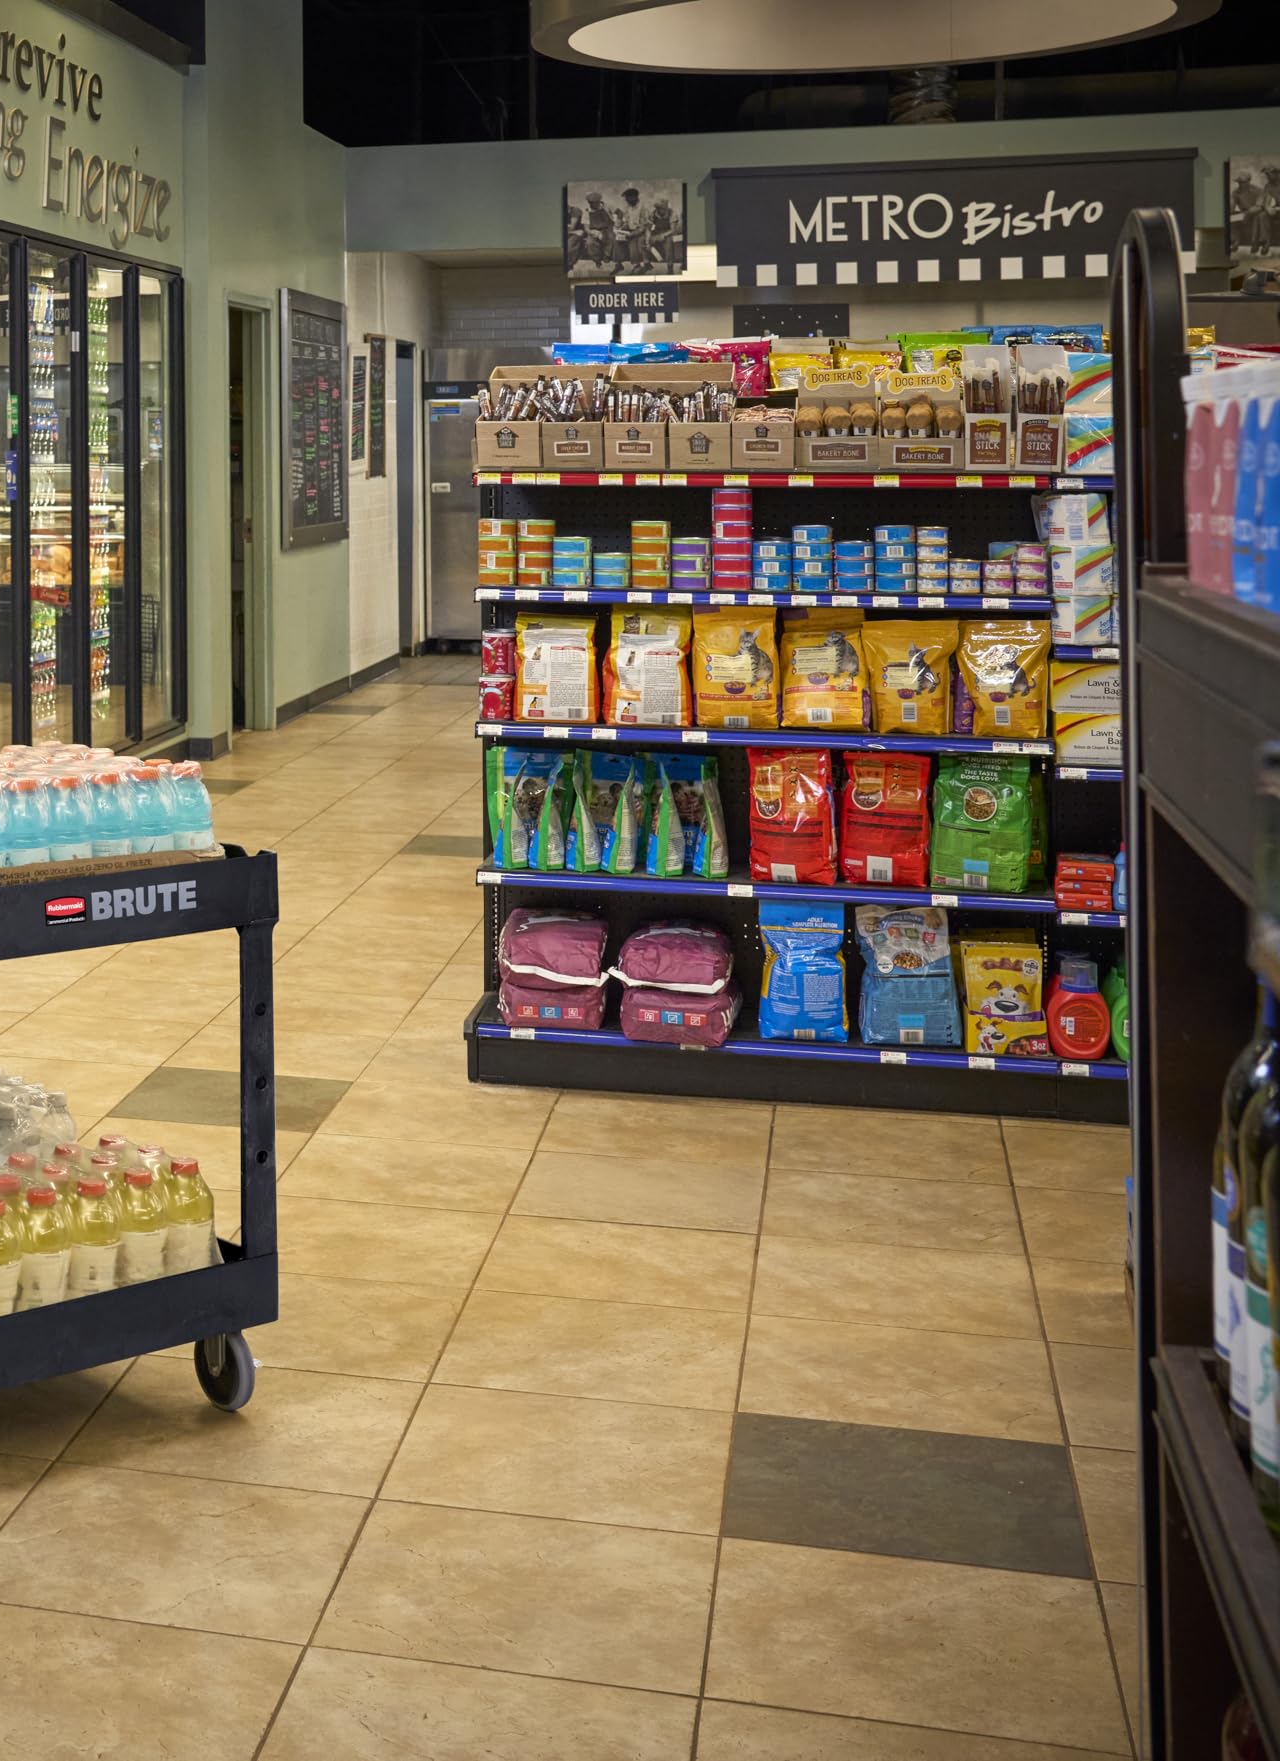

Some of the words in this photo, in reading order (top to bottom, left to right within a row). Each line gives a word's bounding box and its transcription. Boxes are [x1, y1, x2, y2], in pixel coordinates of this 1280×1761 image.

[42, 115, 170, 249] Energize
[789, 192, 954, 244] METRO
[961, 190, 1104, 246] Bistro
[589, 293, 628, 308] ORDER
[634, 292, 665, 307] HERE
[811, 373, 830, 384] DOG
[833, 371, 862, 382] TREATS
[895, 377, 914, 387] DOG
[917, 375, 947, 385] TREATS
[1026, 432, 1053, 442] SNACK
[975, 441, 1000, 450] STICK
[1026, 441, 1051, 451] STICK
[1088, 679, 1110, 687] Lawn
[1091, 729, 1114, 737] Lawn
[1107, 737, 1119, 745] Ba
[91, 880, 197, 921] BRUTE
[48, 902, 83, 912] Rubbermaid
